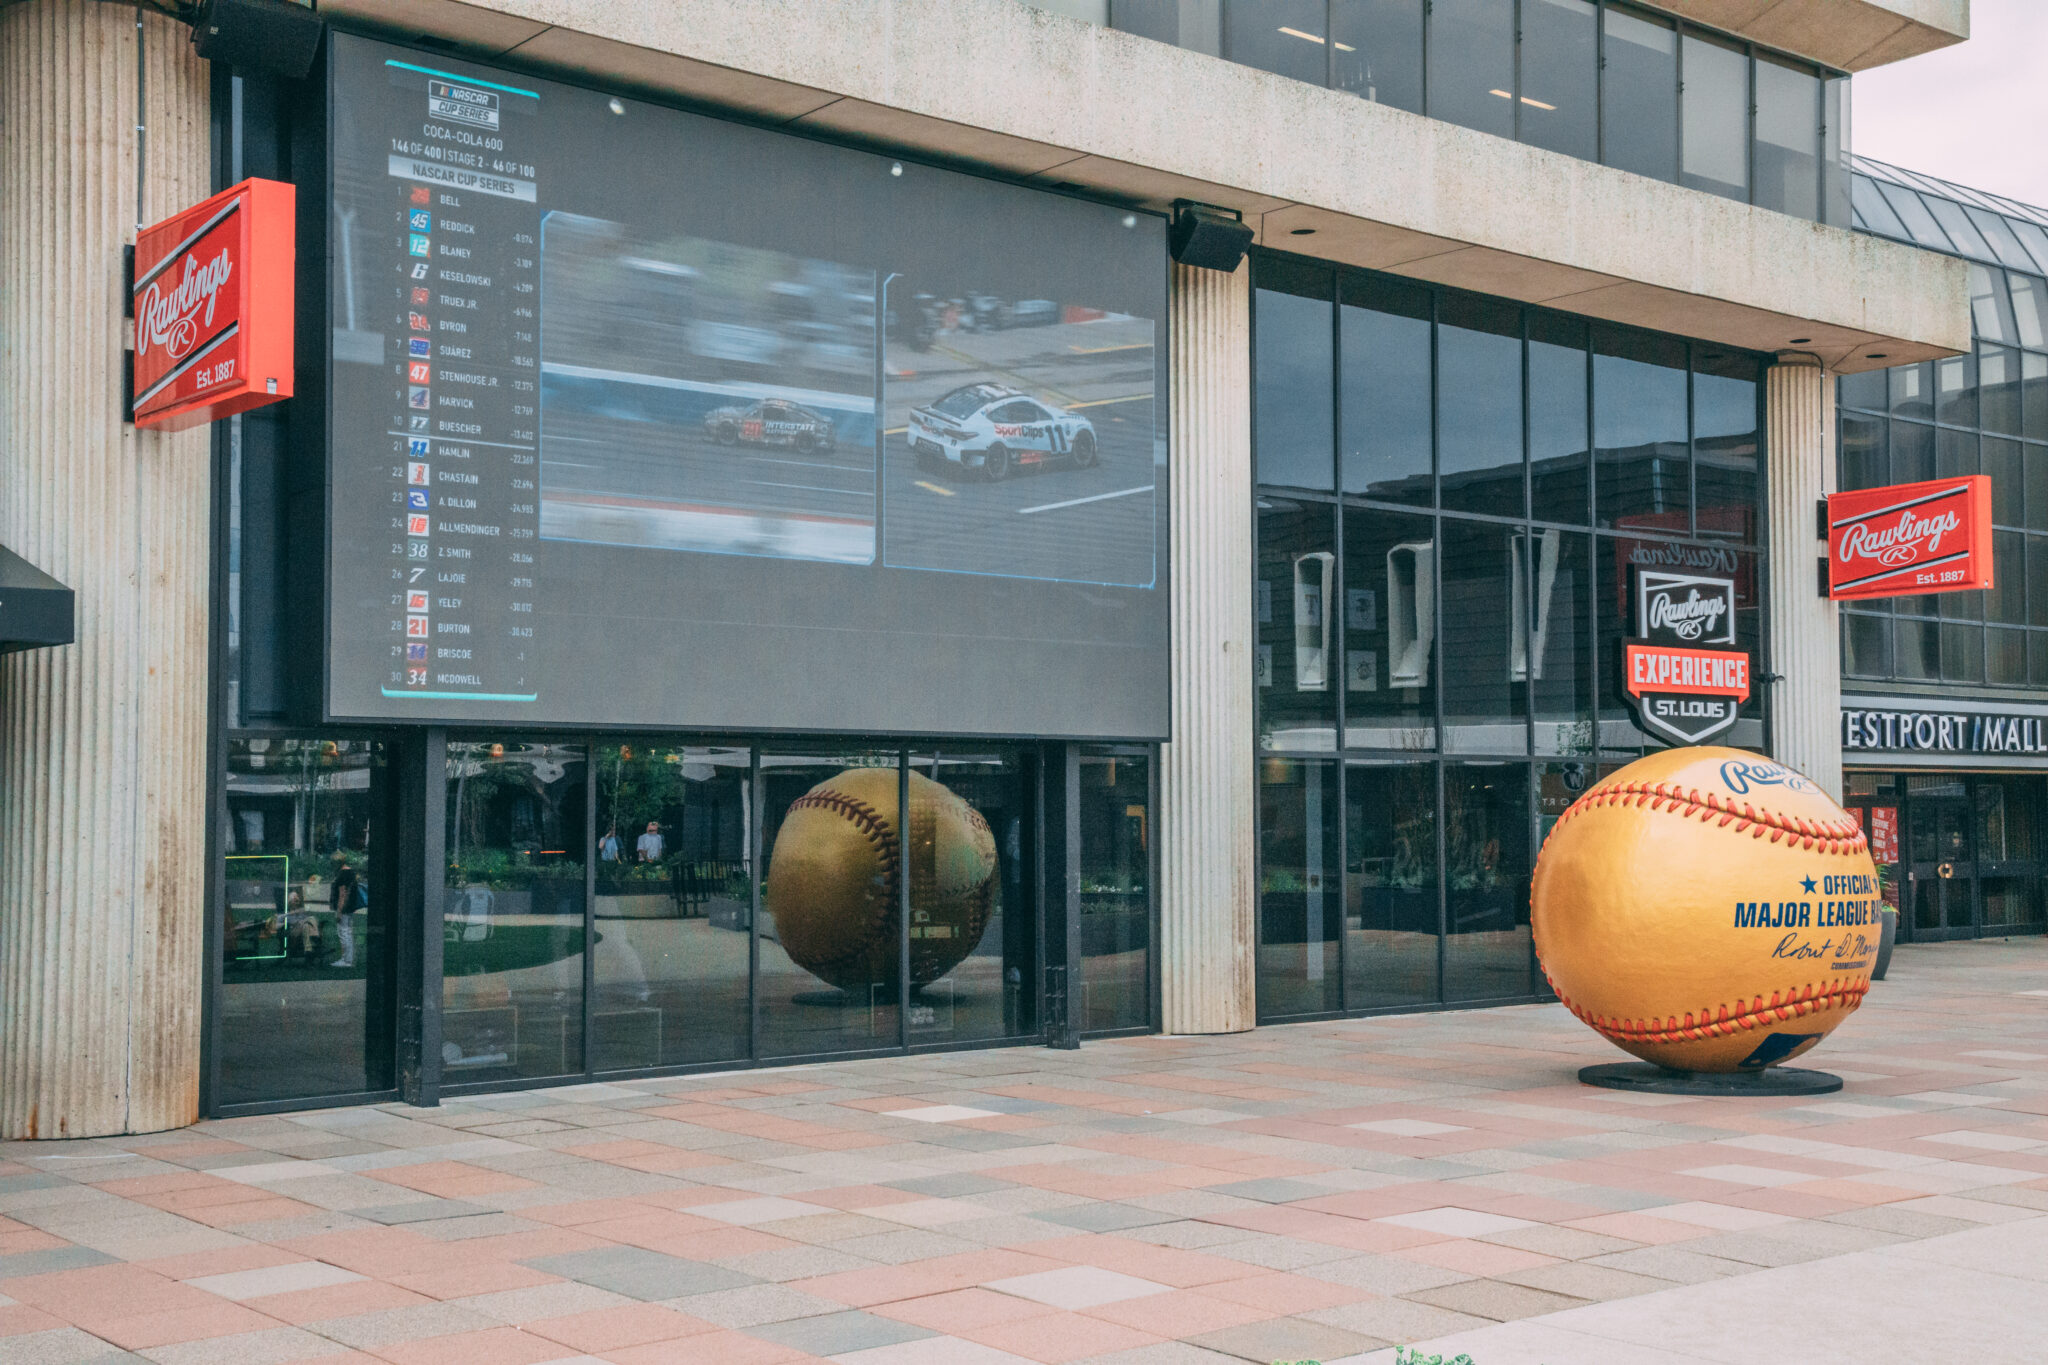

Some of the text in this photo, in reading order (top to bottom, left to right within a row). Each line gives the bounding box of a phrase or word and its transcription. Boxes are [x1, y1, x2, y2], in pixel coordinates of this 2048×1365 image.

[451, 88, 489, 106] NASCAR
[438, 102, 490, 121] CUP SERIES
[423, 124, 503, 151] COCA-COLA 600
[392, 138, 409, 153] 146
[410, 142, 423, 155] OF
[424, 145, 441, 160] 400
[448, 151, 476, 166] STAGE
[478, 156, 483, 168] 2
[493, 159, 504, 172] 46
[506, 161, 517, 174] OF
[519, 164, 535, 178] 100
[412, 164, 515, 194] NASCAR CUP SERIES
[440, 194, 461, 207] BELL
[411, 213, 428, 230] 45
[440, 219, 475, 234] REDDICK
[411, 239, 430, 255] 12
[440, 245, 472, 259] BLANEY
[411, 262, 429, 280] 6
[440, 270, 491, 287] KESELOWSKI
[137, 248, 232, 356] Rawlings
[440, 295, 465, 309] TRUEX
[440, 320, 467, 333] BYRON
[196, 359, 235, 389] Est. 1887
[410, 365, 428, 381] 47
[439, 371, 487, 386] STENHOUSE
[439, 395, 474, 409] HARVICK
[439, 421, 482, 435] BUESCHER
[765, 421, 816, 432] INTERSTATE
[1045, 424, 1068, 453] 11
[409, 440, 428, 458] 11
[439, 446, 470, 459] HAMLIN
[439, 471, 479, 485] CHASTAIN
[409, 491, 428, 507] 3
[448, 498, 477, 509] DILLON
[438, 522, 500, 537] ALLMENDINGER
[1839, 511, 1960, 563] Rawlings
[408, 543, 428, 558] 38
[447, 549, 471, 559] SMITH
[409, 567, 427, 583] 7
[438, 573, 466, 584] LAJOIE
[1916, 570, 1965, 585] Est. 1887
[438, 598, 461, 609] YELEY
[1650, 588, 1726, 632] Rawlings
[408, 618, 427, 636] 21
[438, 623, 470, 635] BURTON
[438, 648, 472, 659] BRISCOE
[408, 669, 427, 686] 34
[437, 674, 482, 685] MCDOWELL
[1634, 653, 1746, 689] EXPERIENCE
[1656, 700, 1725, 718] ST. LOUIS
[1983, 716, 2048, 751] MALL
[1823, 875, 1873, 895] OFFICIAL
[1734, 901, 1811, 928] MAJOR
[1817, 900, 1868, 927] LEAGUE
